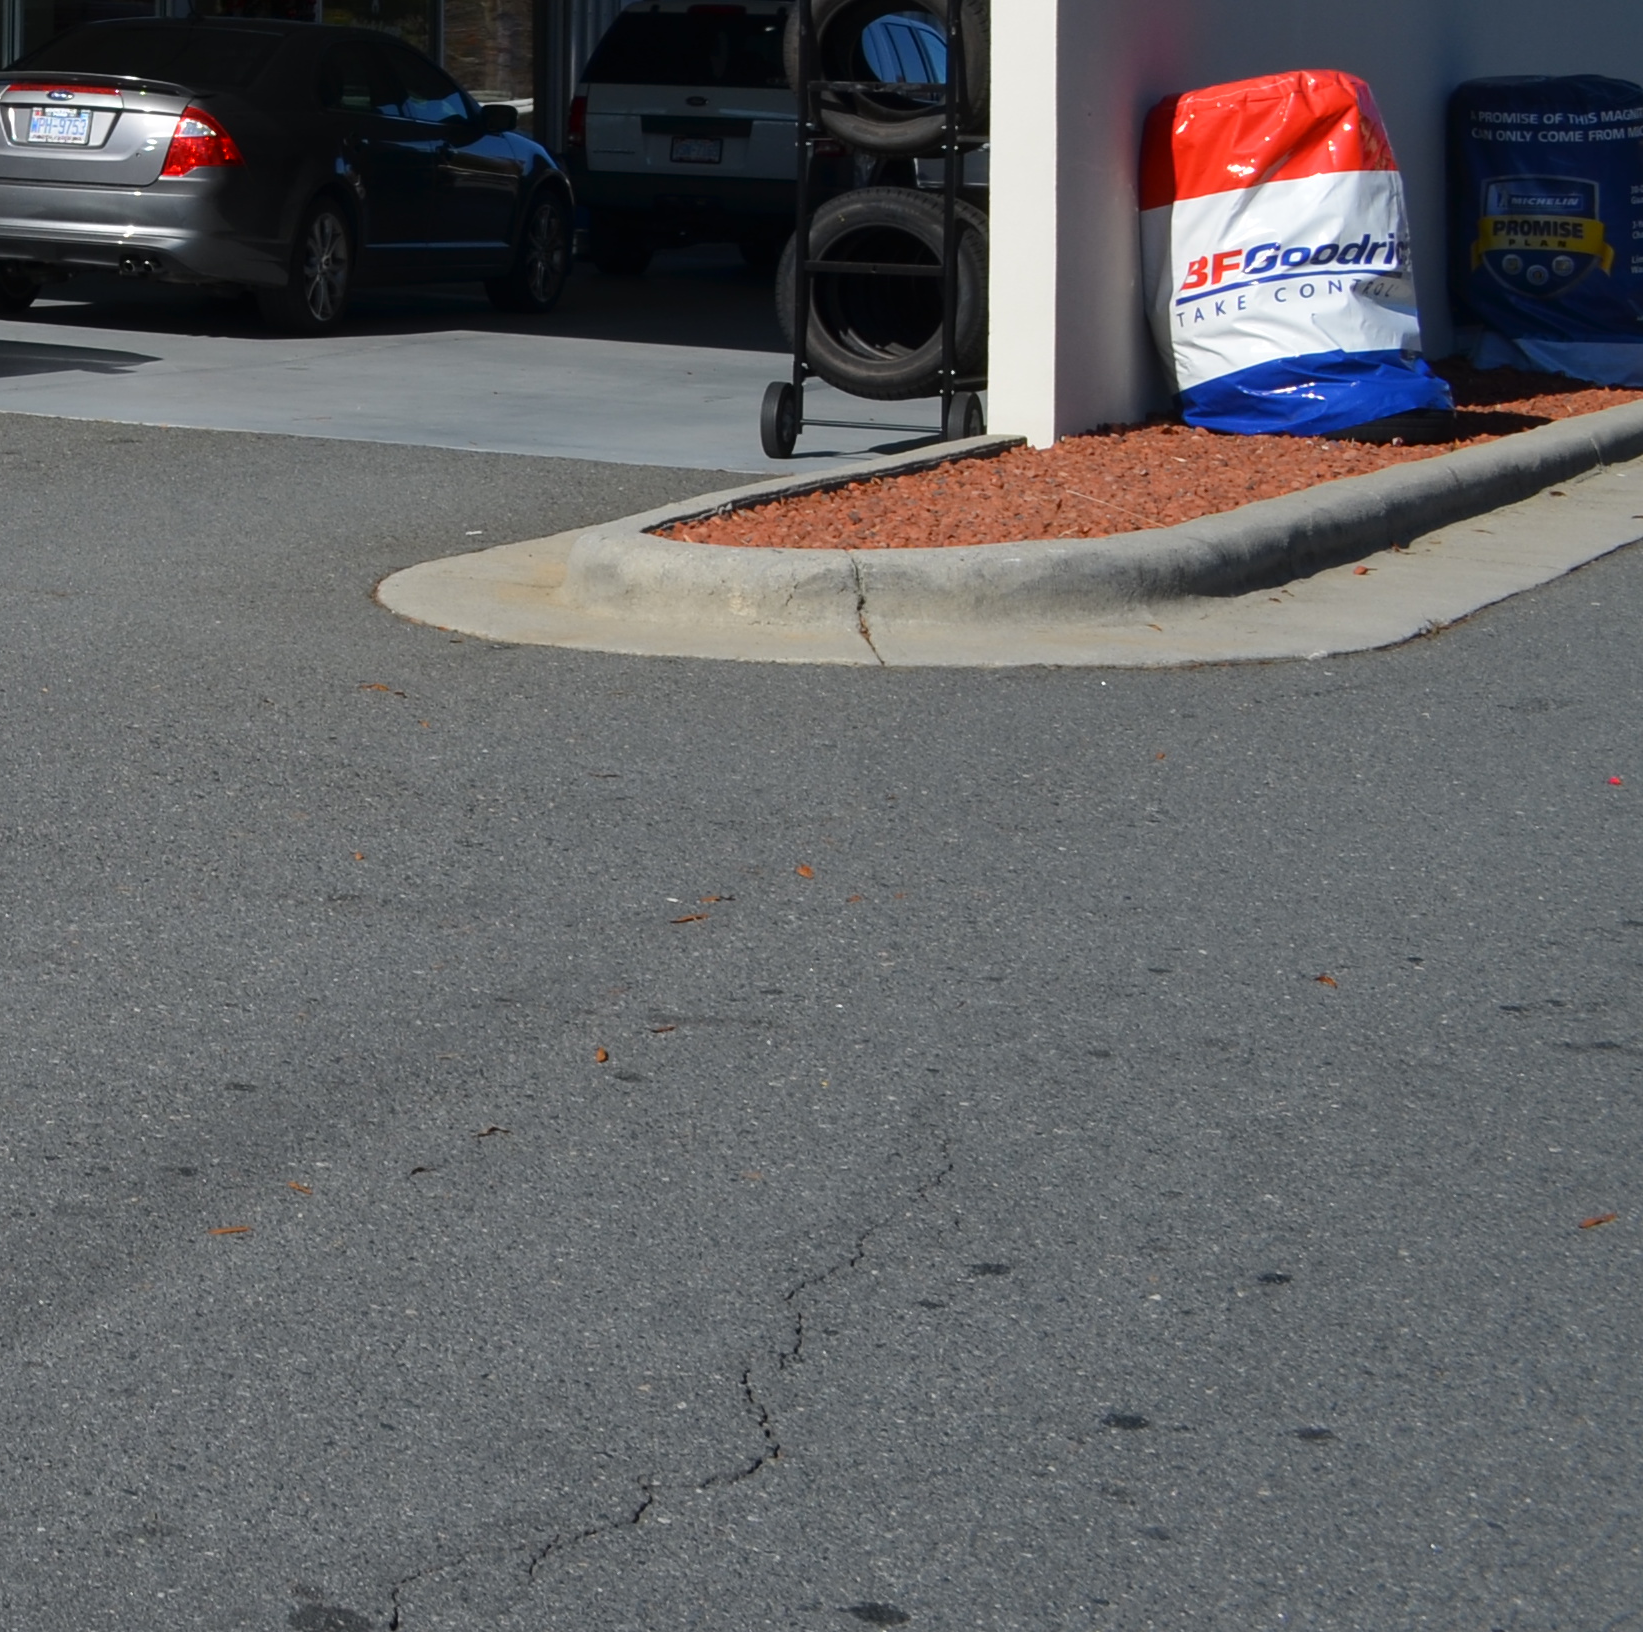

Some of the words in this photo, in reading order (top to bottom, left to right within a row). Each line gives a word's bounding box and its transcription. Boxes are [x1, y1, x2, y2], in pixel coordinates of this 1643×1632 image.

[1478, 111, 1538, 124] PROMISE
[1543, 113, 1564, 124] OF
[1567, 112, 1597, 125] THIS
[1496, 130, 1533, 142] ONLY
[1537, 131, 1584, 142] COME
[1588, 128, 1625, 142] FROM
[1511, 197, 1579, 206] MICHELIN
[1492, 220, 1584, 239] PROMISE
[1508, 238, 1567, 248] PLAN
[1176, 295, 1247, 327] TAKE
[1274, 279, 1398, 303] CONTROL
